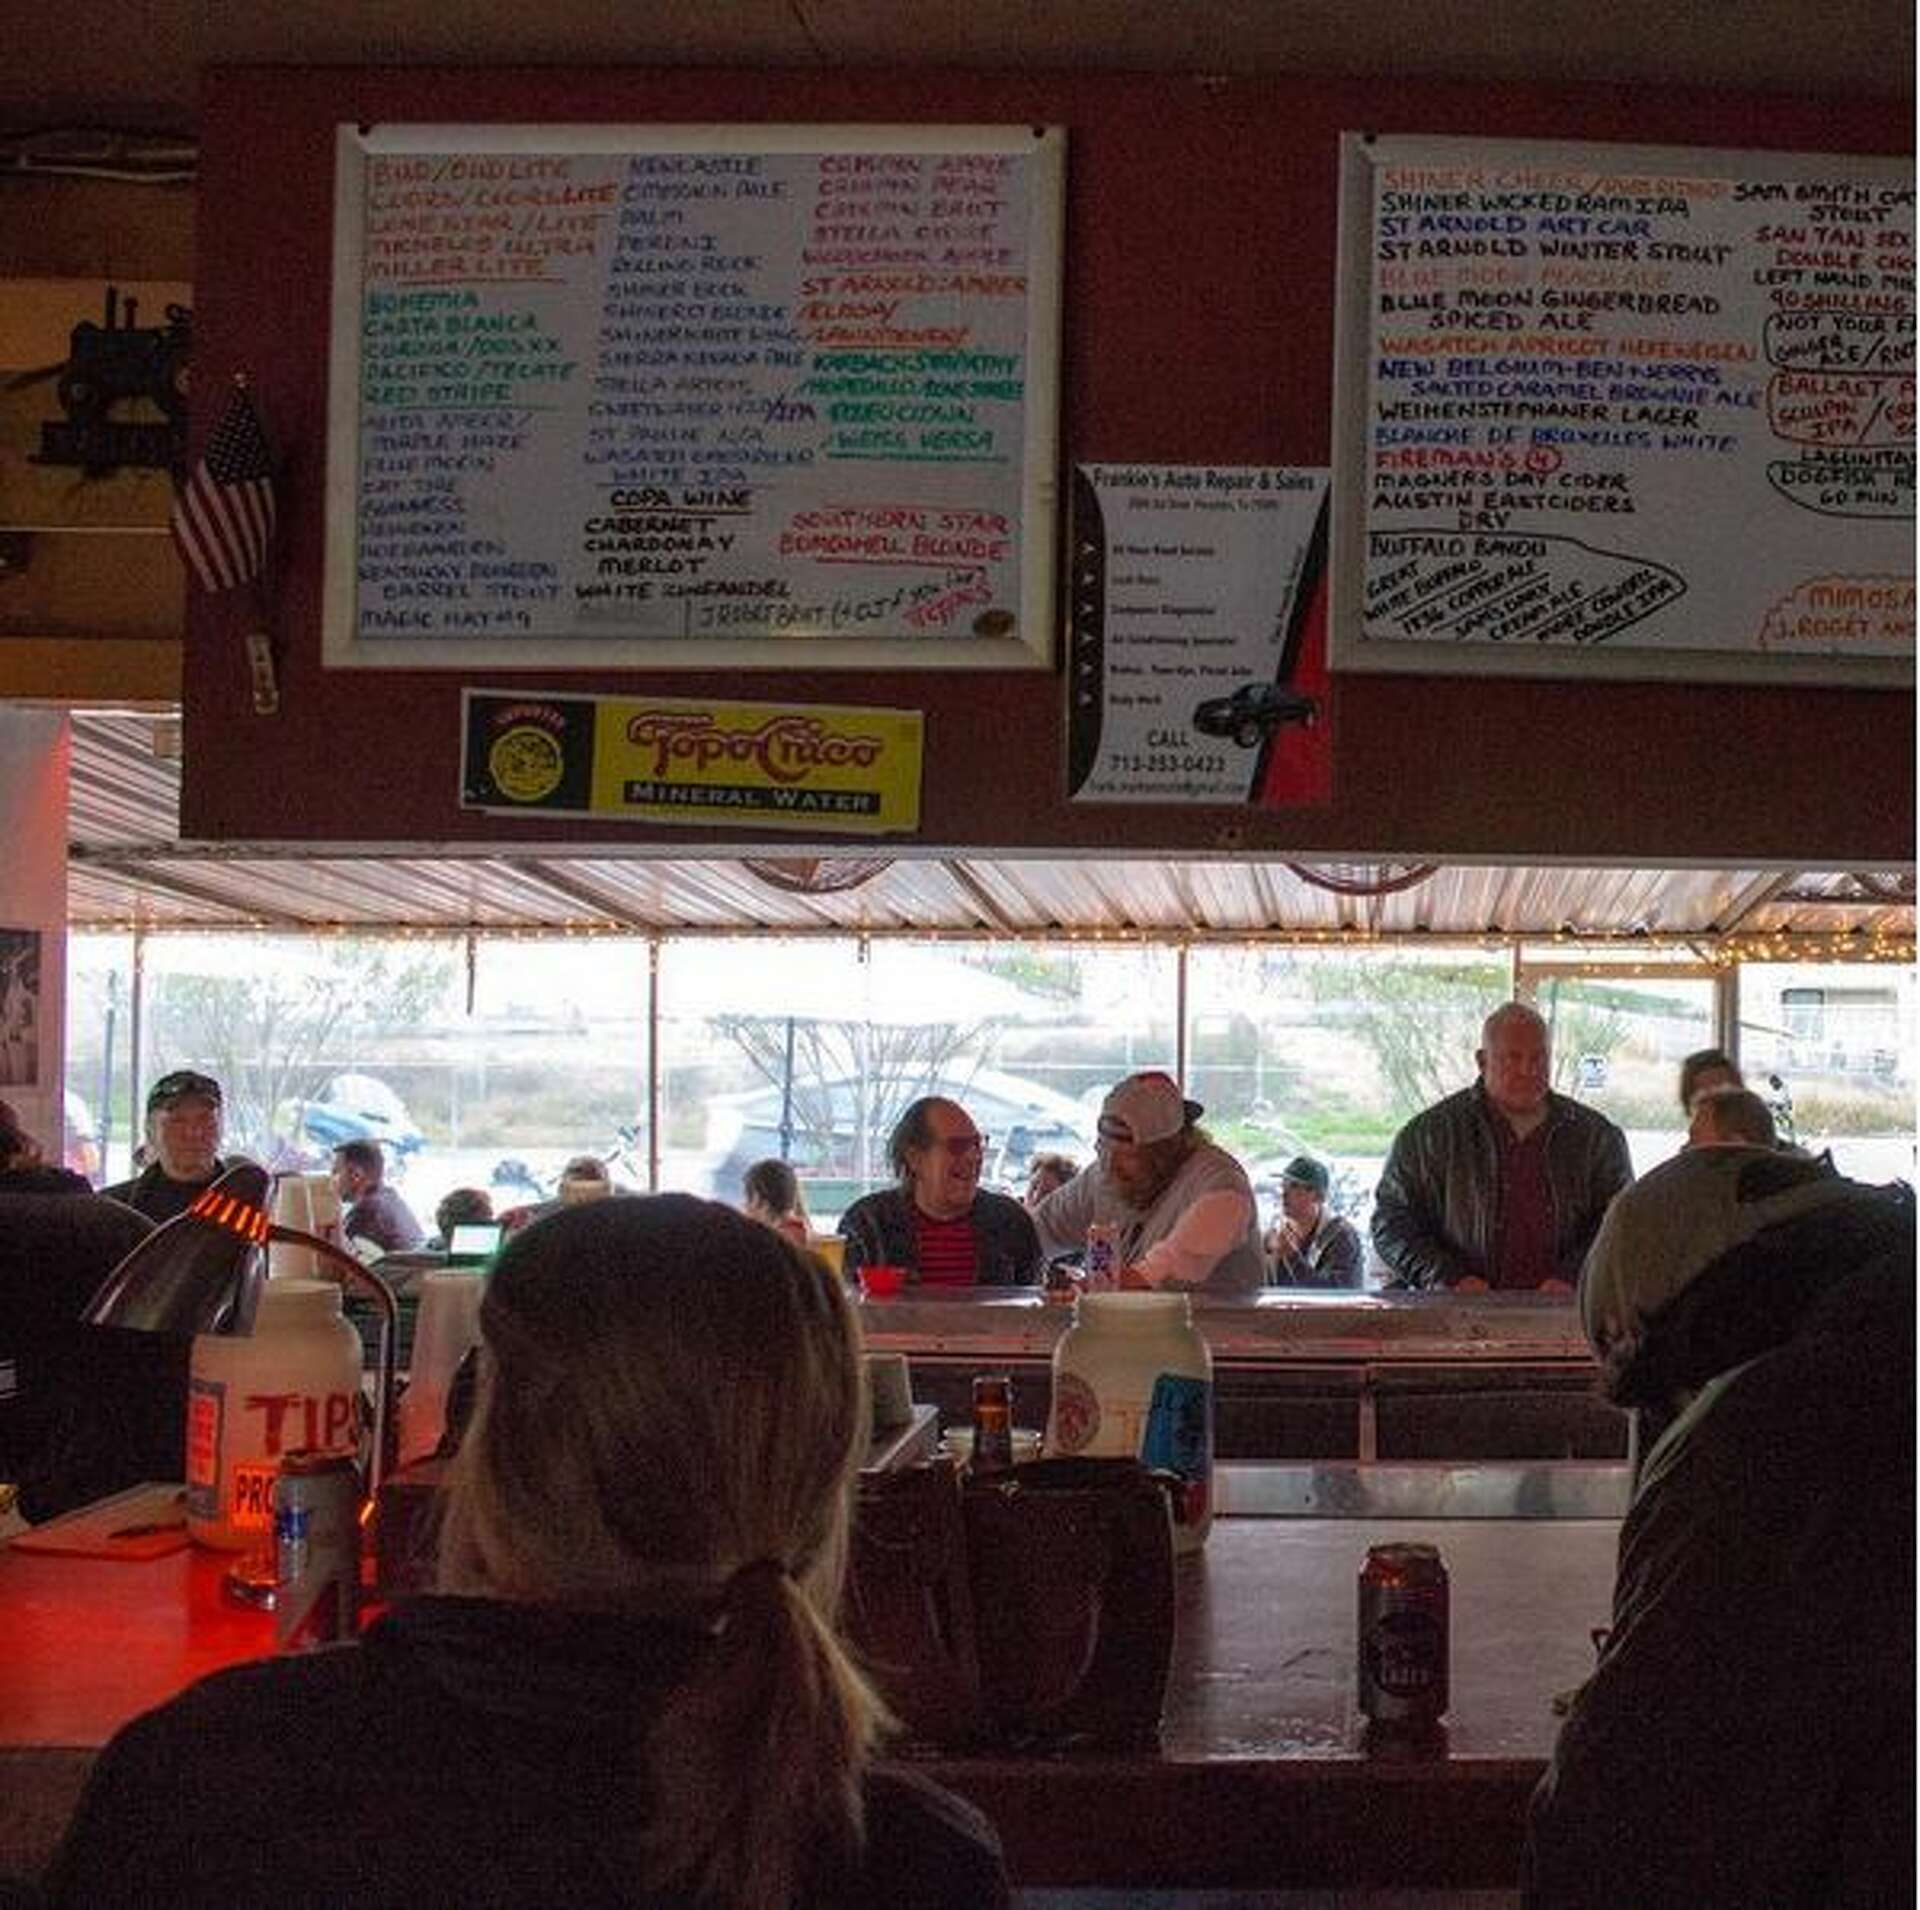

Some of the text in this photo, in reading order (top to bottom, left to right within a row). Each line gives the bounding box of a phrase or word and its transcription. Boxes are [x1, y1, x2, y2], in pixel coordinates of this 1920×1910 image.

[1380, 191, 1471, 213] SHINER
[1479, 193, 1571, 214] WICKED
[1732, 183, 1789, 202] SAM
[1807, 205, 1892, 223] STOUT
[1380, 215, 1655, 240] ST ARNOLD ART CAR
[1378, 238, 1736, 267] ST ARNOLD WINTER STOUT
[1380, 290, 1721, 316] BLUE MOON GINGERBREAD
[1427, 311, 1596, 332] SPICED ALE
[1775, 315, 1821, 331] NOT
[1378, 358, 1436, 379] NEW
[1496, 380, 1603, 401] CARAMEL
[1621, 405, 1702, 429] LAGER
[1093, 467, 1316, 496] Frankie's Auto Repair & Sales
[1375, 472, 1495, 489] MAGNERS
[1372, 490, 1473, 511] AUSTIN
[585, 517, 717, 534] CABERNET
[585, 535, 736, 552] CHARDONAY
[599, 556, 708, 575] MERLOT
[1147, 729, 1190, 748] CALL
[630, 783, 873, 812] MINERAL WATER
